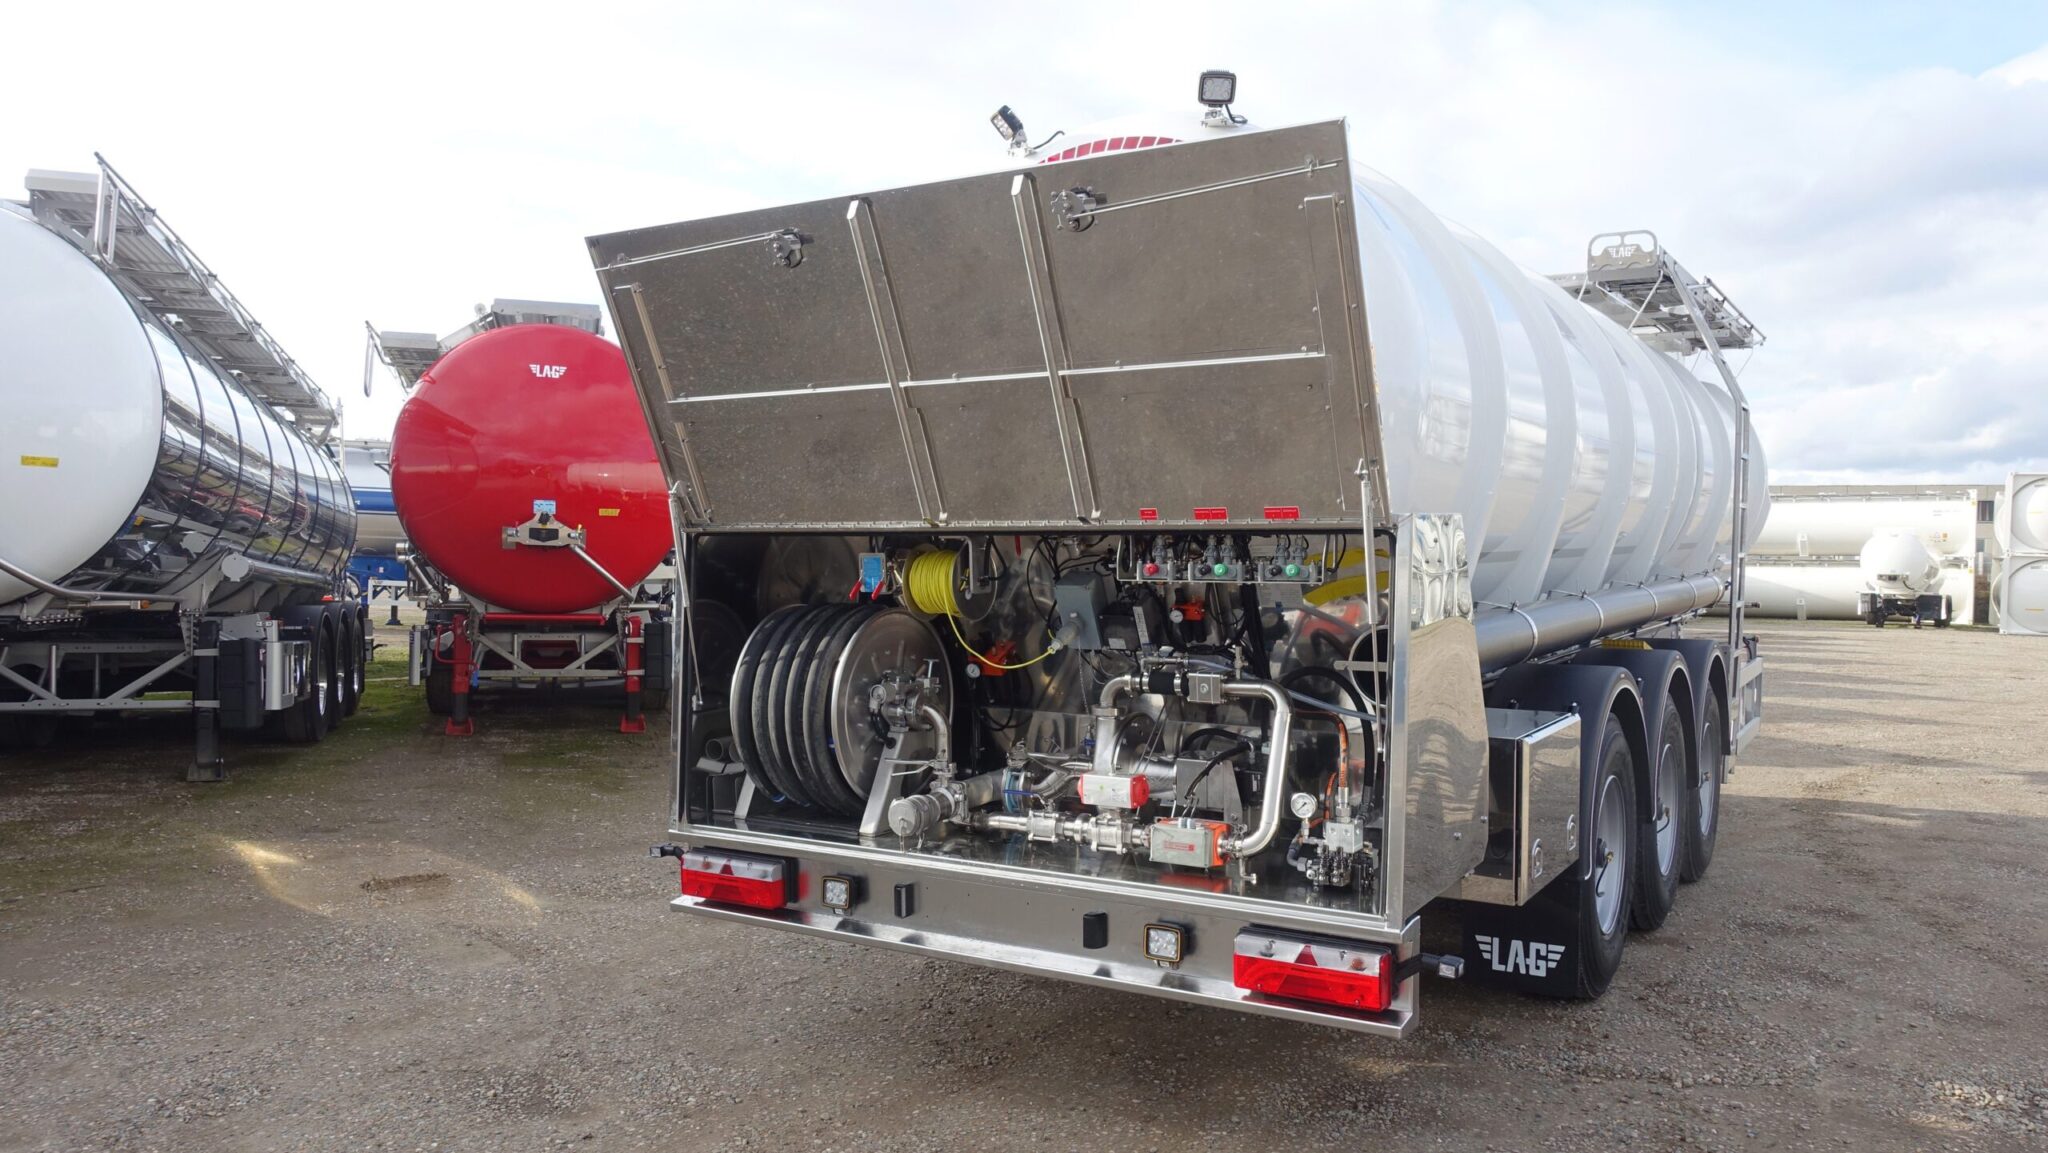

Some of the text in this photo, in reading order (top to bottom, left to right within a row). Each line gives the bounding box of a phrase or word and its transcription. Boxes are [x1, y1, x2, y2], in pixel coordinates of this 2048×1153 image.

[1612, 246, 1632, 258] LAG
[535, 364, 561, 379] LAG
[1490, 936, 1549, 977] LAG
